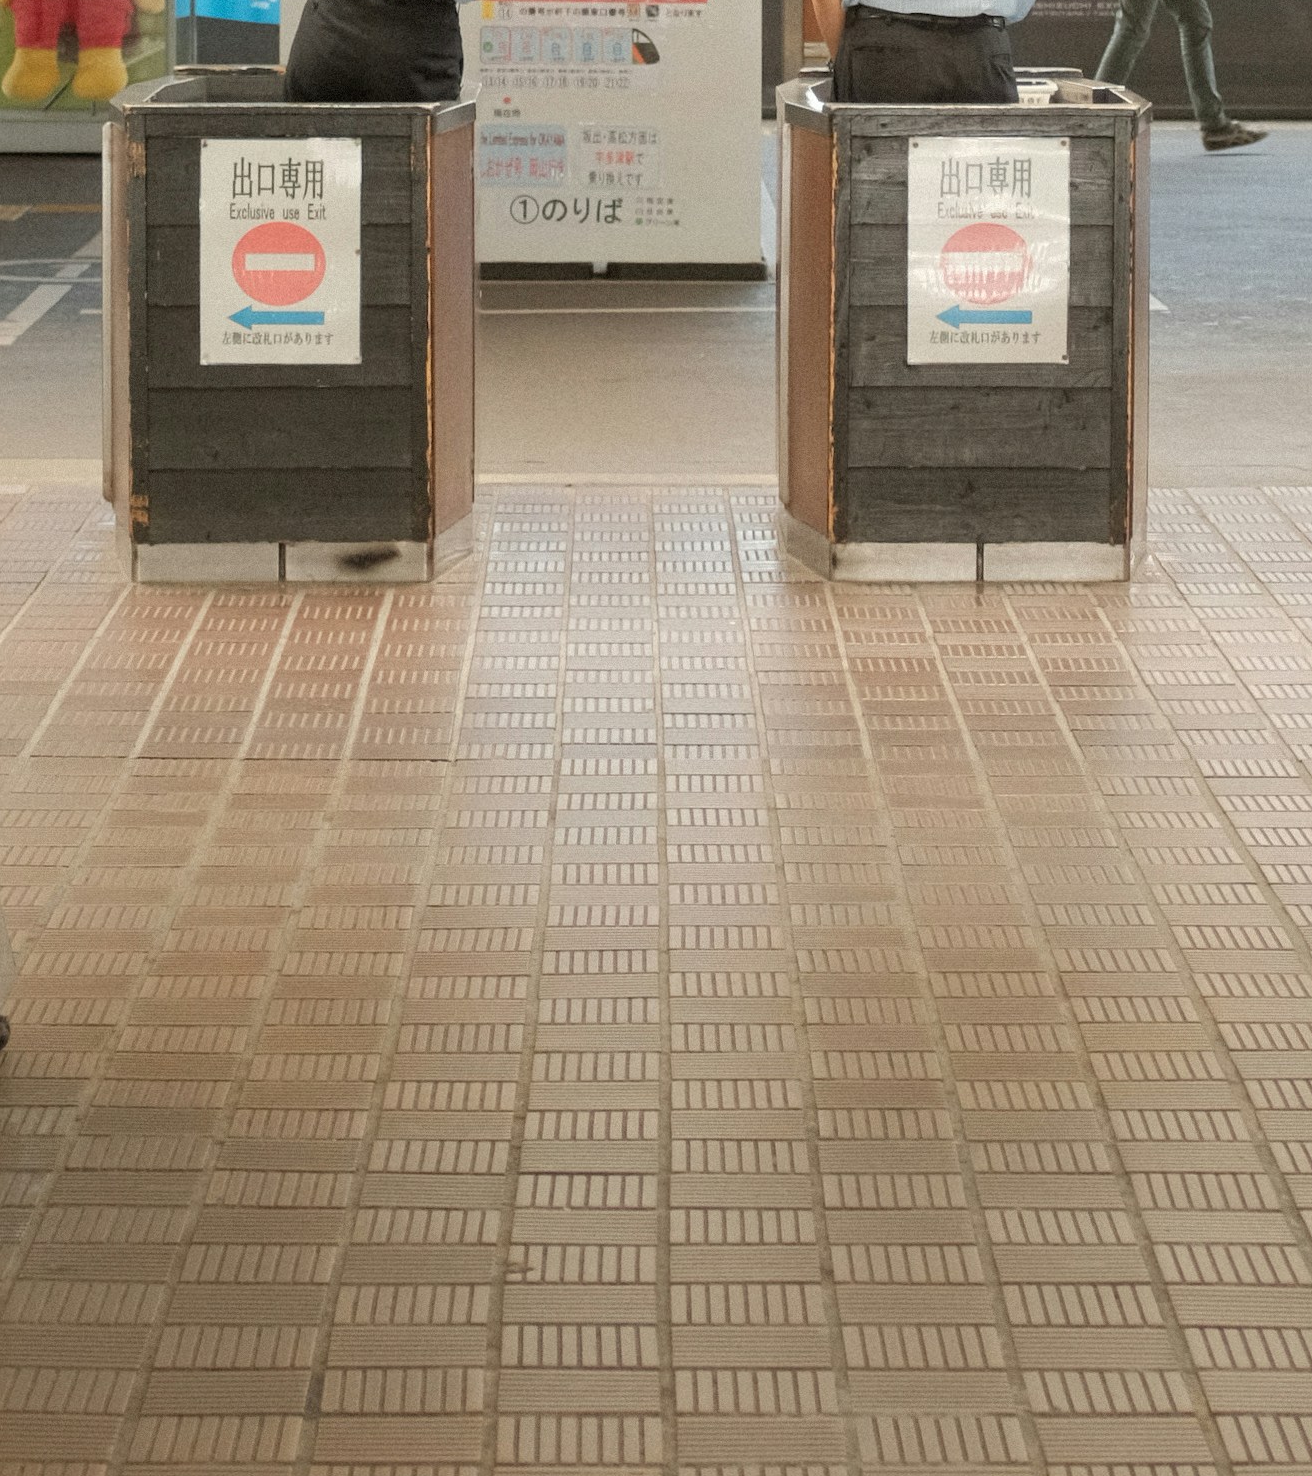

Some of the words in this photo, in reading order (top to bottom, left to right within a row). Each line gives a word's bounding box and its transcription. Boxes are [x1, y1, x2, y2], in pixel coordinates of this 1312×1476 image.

[232, 156, 325, 200] 出口専用
[940, 155, 1032, 198] 出口専用
[229, 202, 275, 220] Exclusive
[282, 206, 300, 220] use
[307, 203, 327, 220] Exit
[222, 331, 335, 346] 左側に改札口があります
[929, 330, 1042, 345] 左側に改札口があります
